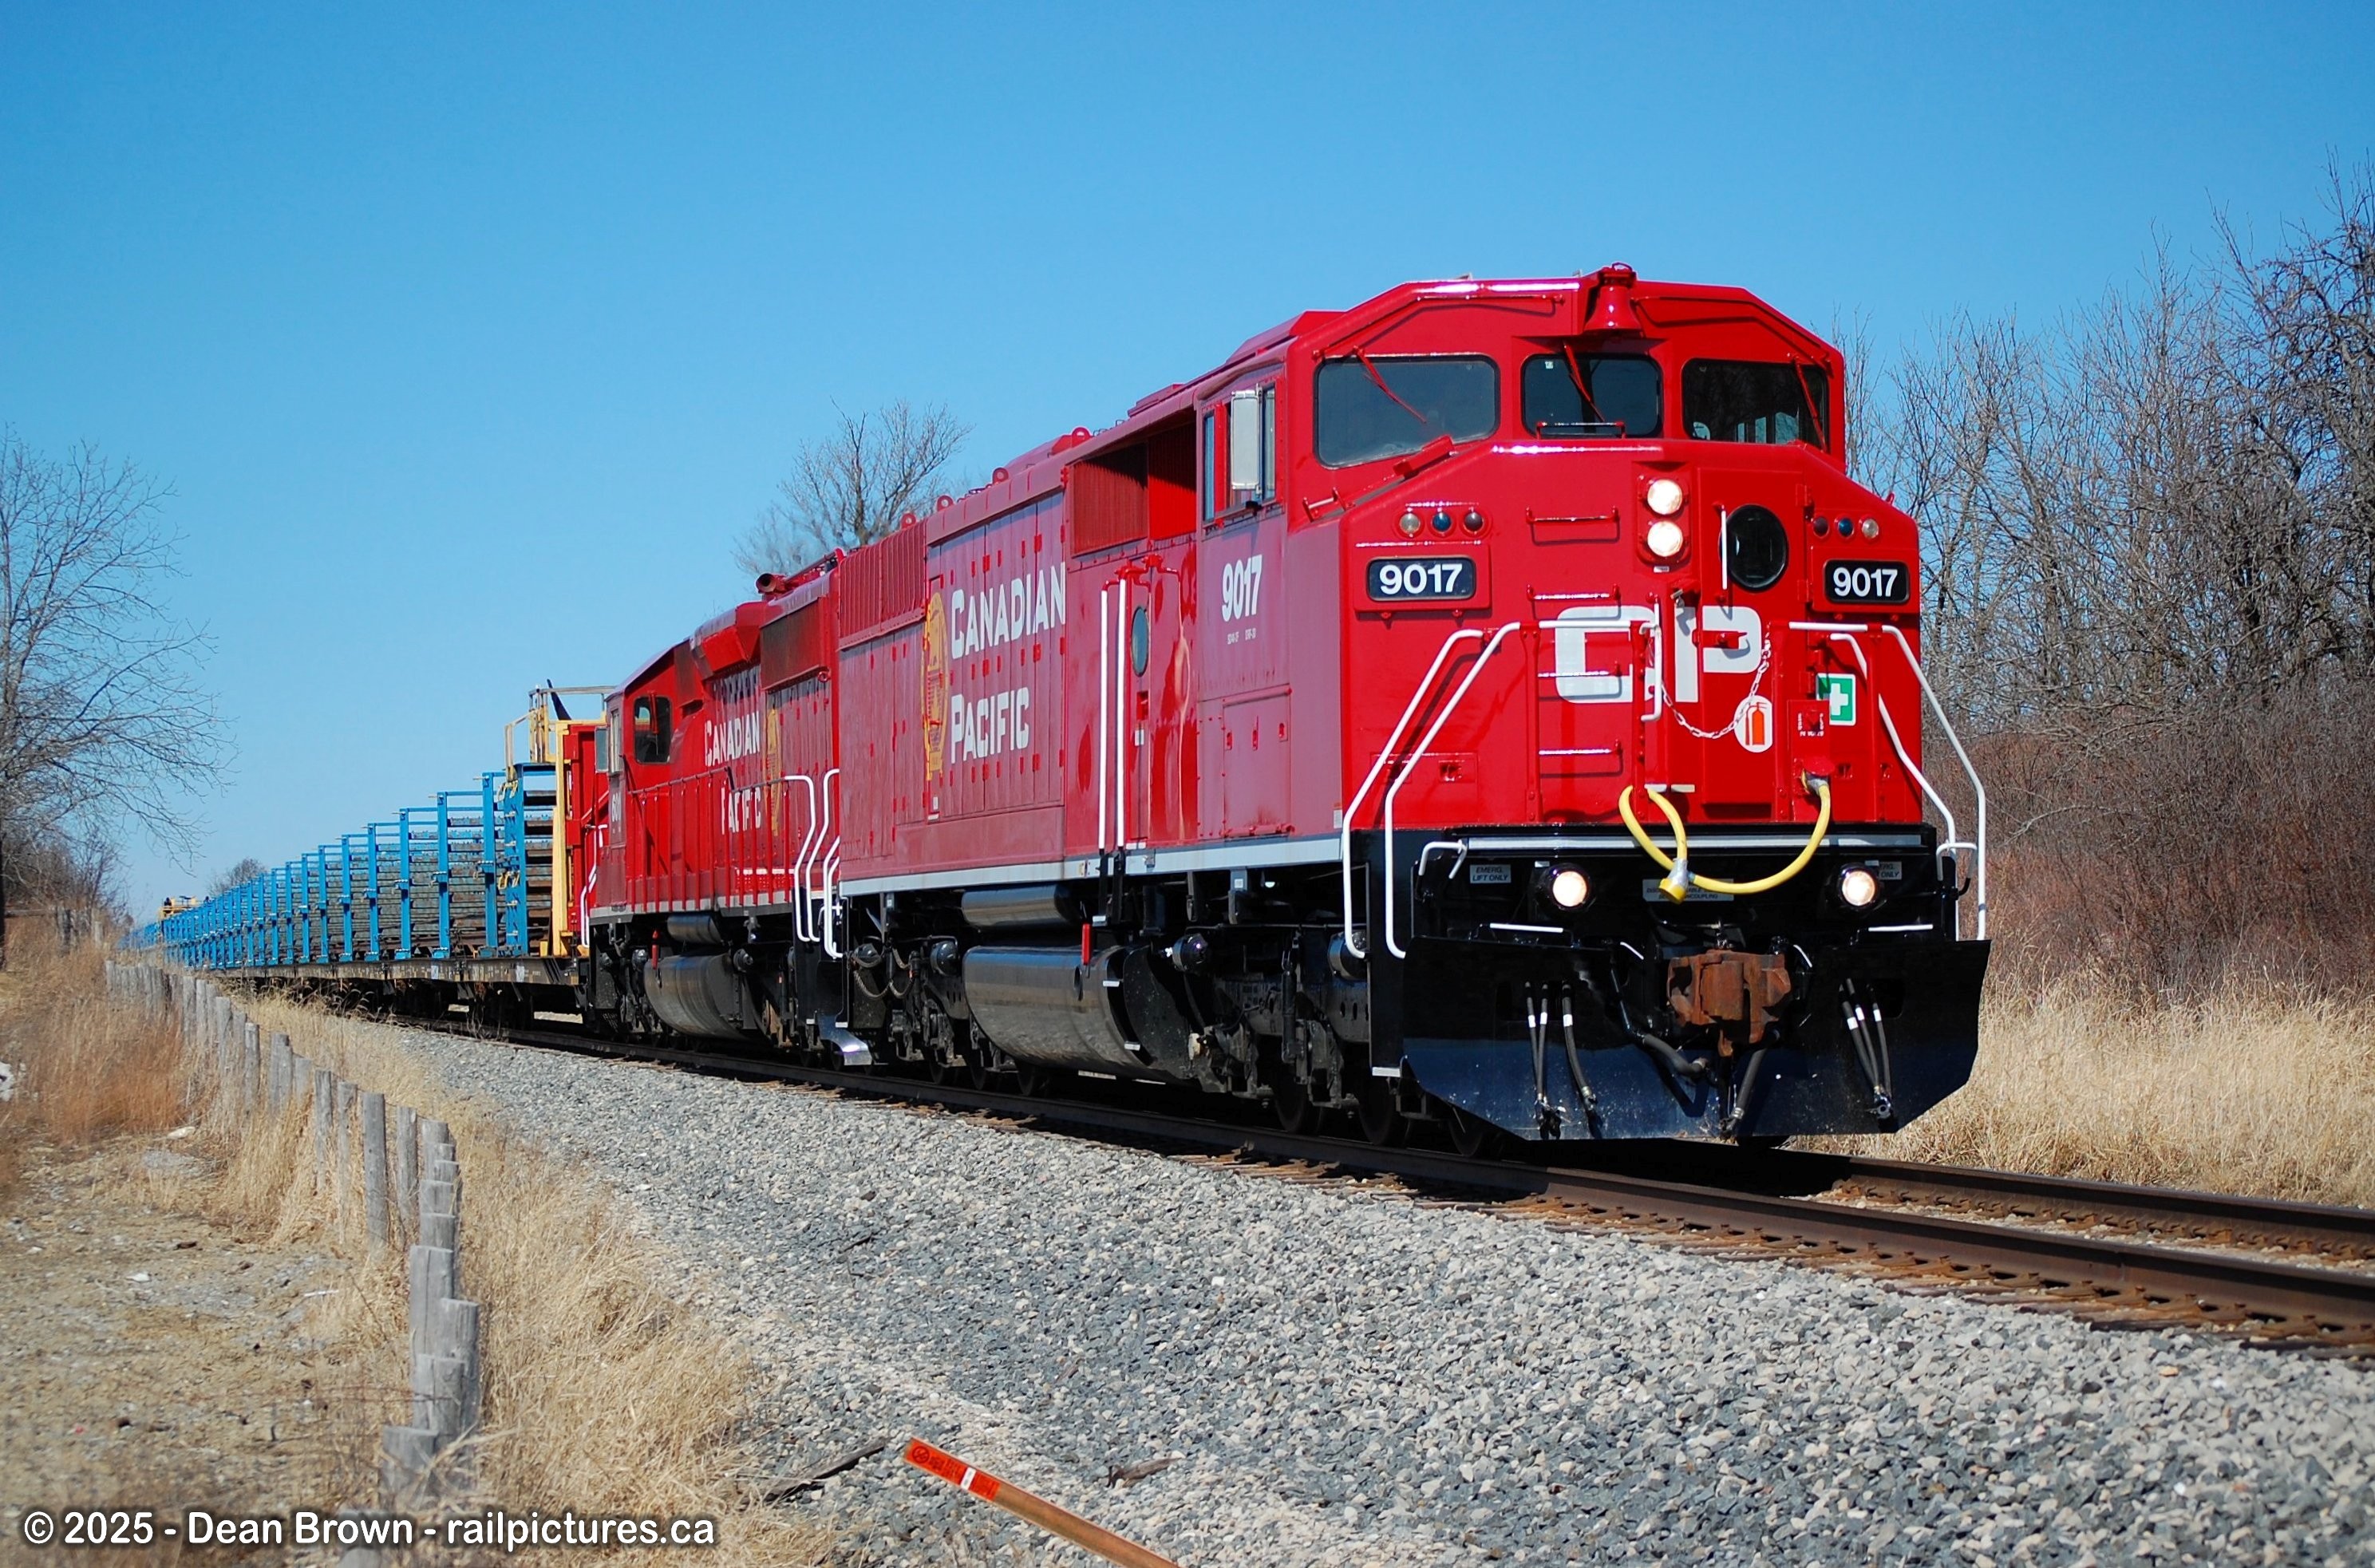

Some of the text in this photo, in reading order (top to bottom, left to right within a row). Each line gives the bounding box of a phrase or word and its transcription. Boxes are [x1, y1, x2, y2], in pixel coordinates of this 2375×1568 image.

[1221, 554, 1263, 622] 9017
[1379, 563, 1463, 594] 9017
[1833, 567, 1899, 597] 9017
[951, 561, 1066, 660] CANADIAN
[1555, 605, 1762, 704] CP
[705, 710, 760, 767] CANADIAN
[951, 687, 1029, 764] PACIFIC
[721, 787, 761, 835] ACIFC
